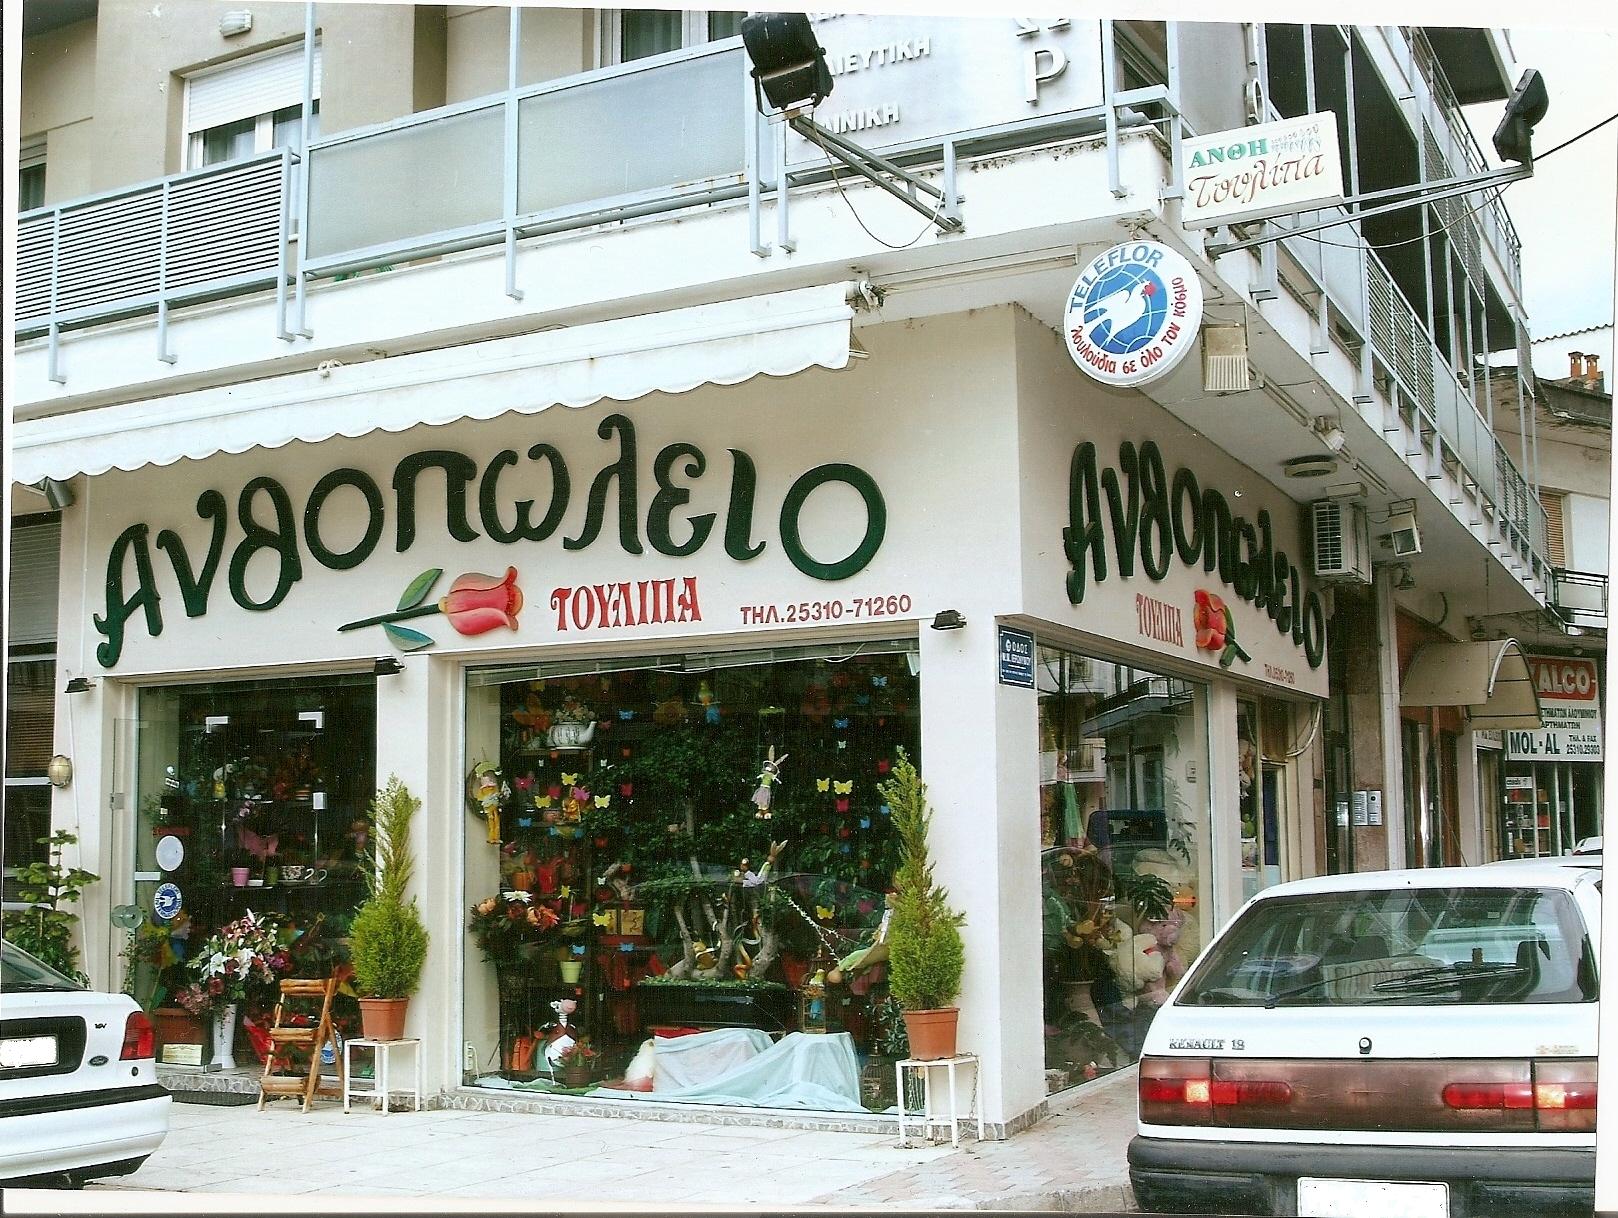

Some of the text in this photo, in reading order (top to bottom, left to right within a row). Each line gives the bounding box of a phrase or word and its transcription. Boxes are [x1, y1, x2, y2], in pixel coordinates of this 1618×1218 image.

[1189, 138, 1268, 168] ΑΝΘΗ
[1069, 245, 1164, 313] TELEFLOR
[551, 576, 702, 631] ΤΟΥΛΙΠΑ
[741, 595, 912, 624] ΤΗΛ.25310-71260
[1137, 593, 1184, 647] ΤΟΥΛΙΠΑ
[1510, 731, 1537, 754] MOL
[1545, 733, 1560, 755] AL
